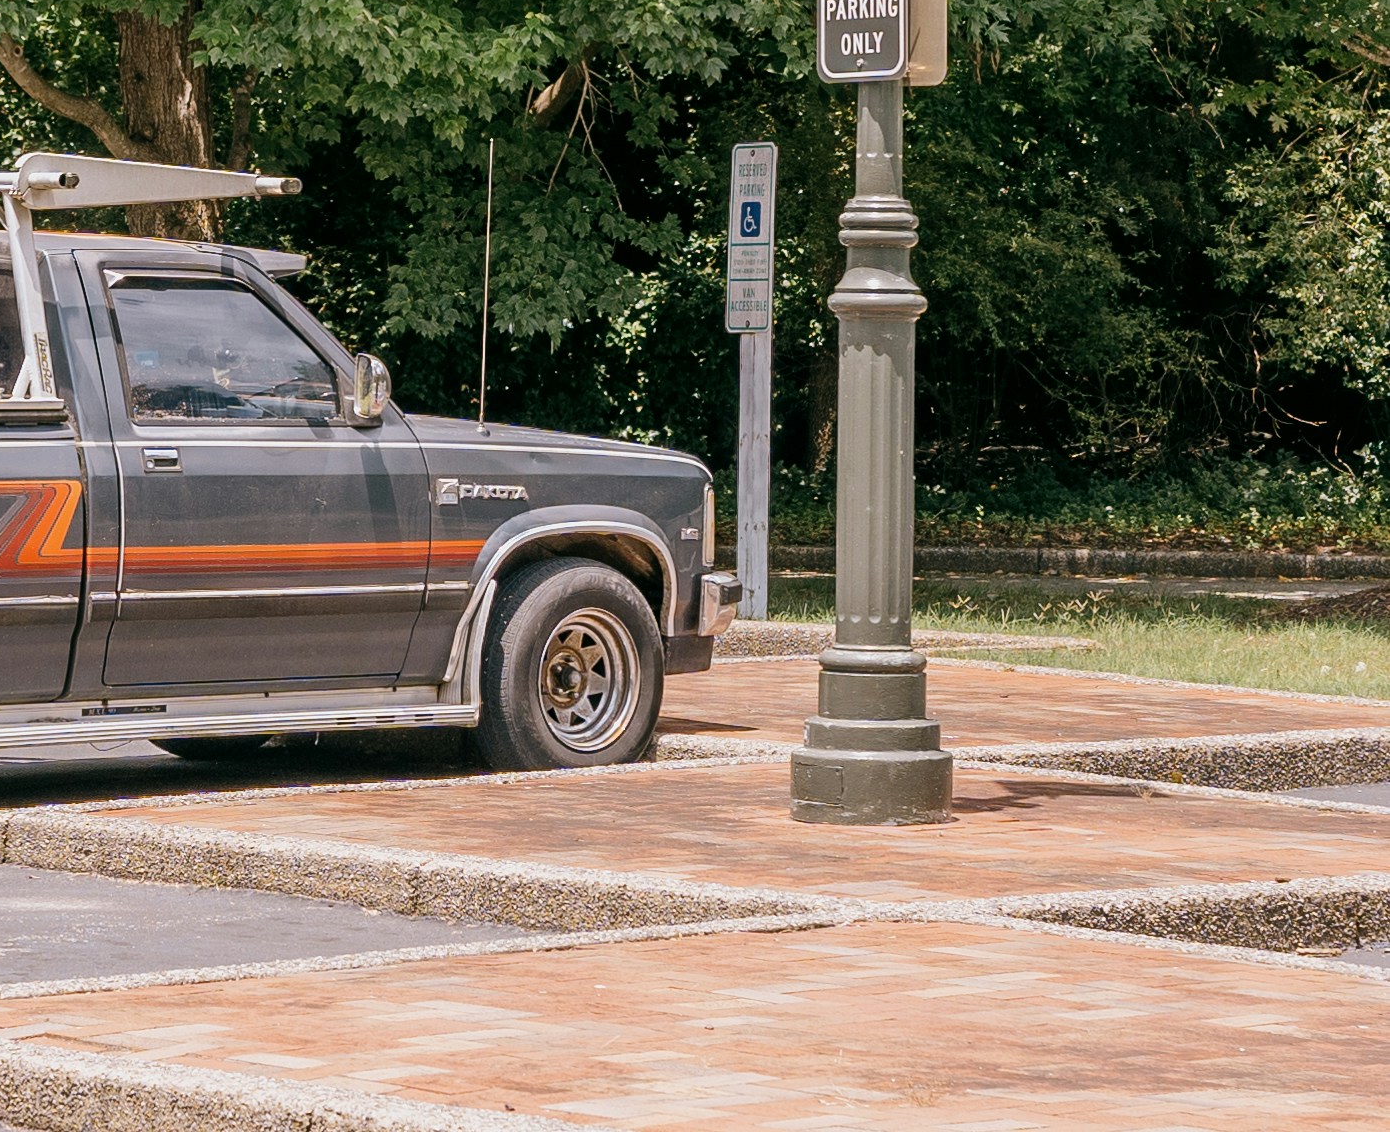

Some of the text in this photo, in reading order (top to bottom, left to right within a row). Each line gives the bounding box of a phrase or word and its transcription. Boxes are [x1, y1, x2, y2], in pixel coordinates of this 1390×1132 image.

[840, 31, 884, 56] ONLY
[738, 163, 767, 177] RESERVED
[739, 183, 765, 197] PARKING
[742, 288, 756, 298] VAN
[730, 300, 767, 312] ACCESSIBLE
[459, 484, 529, 501] DAKOTA
